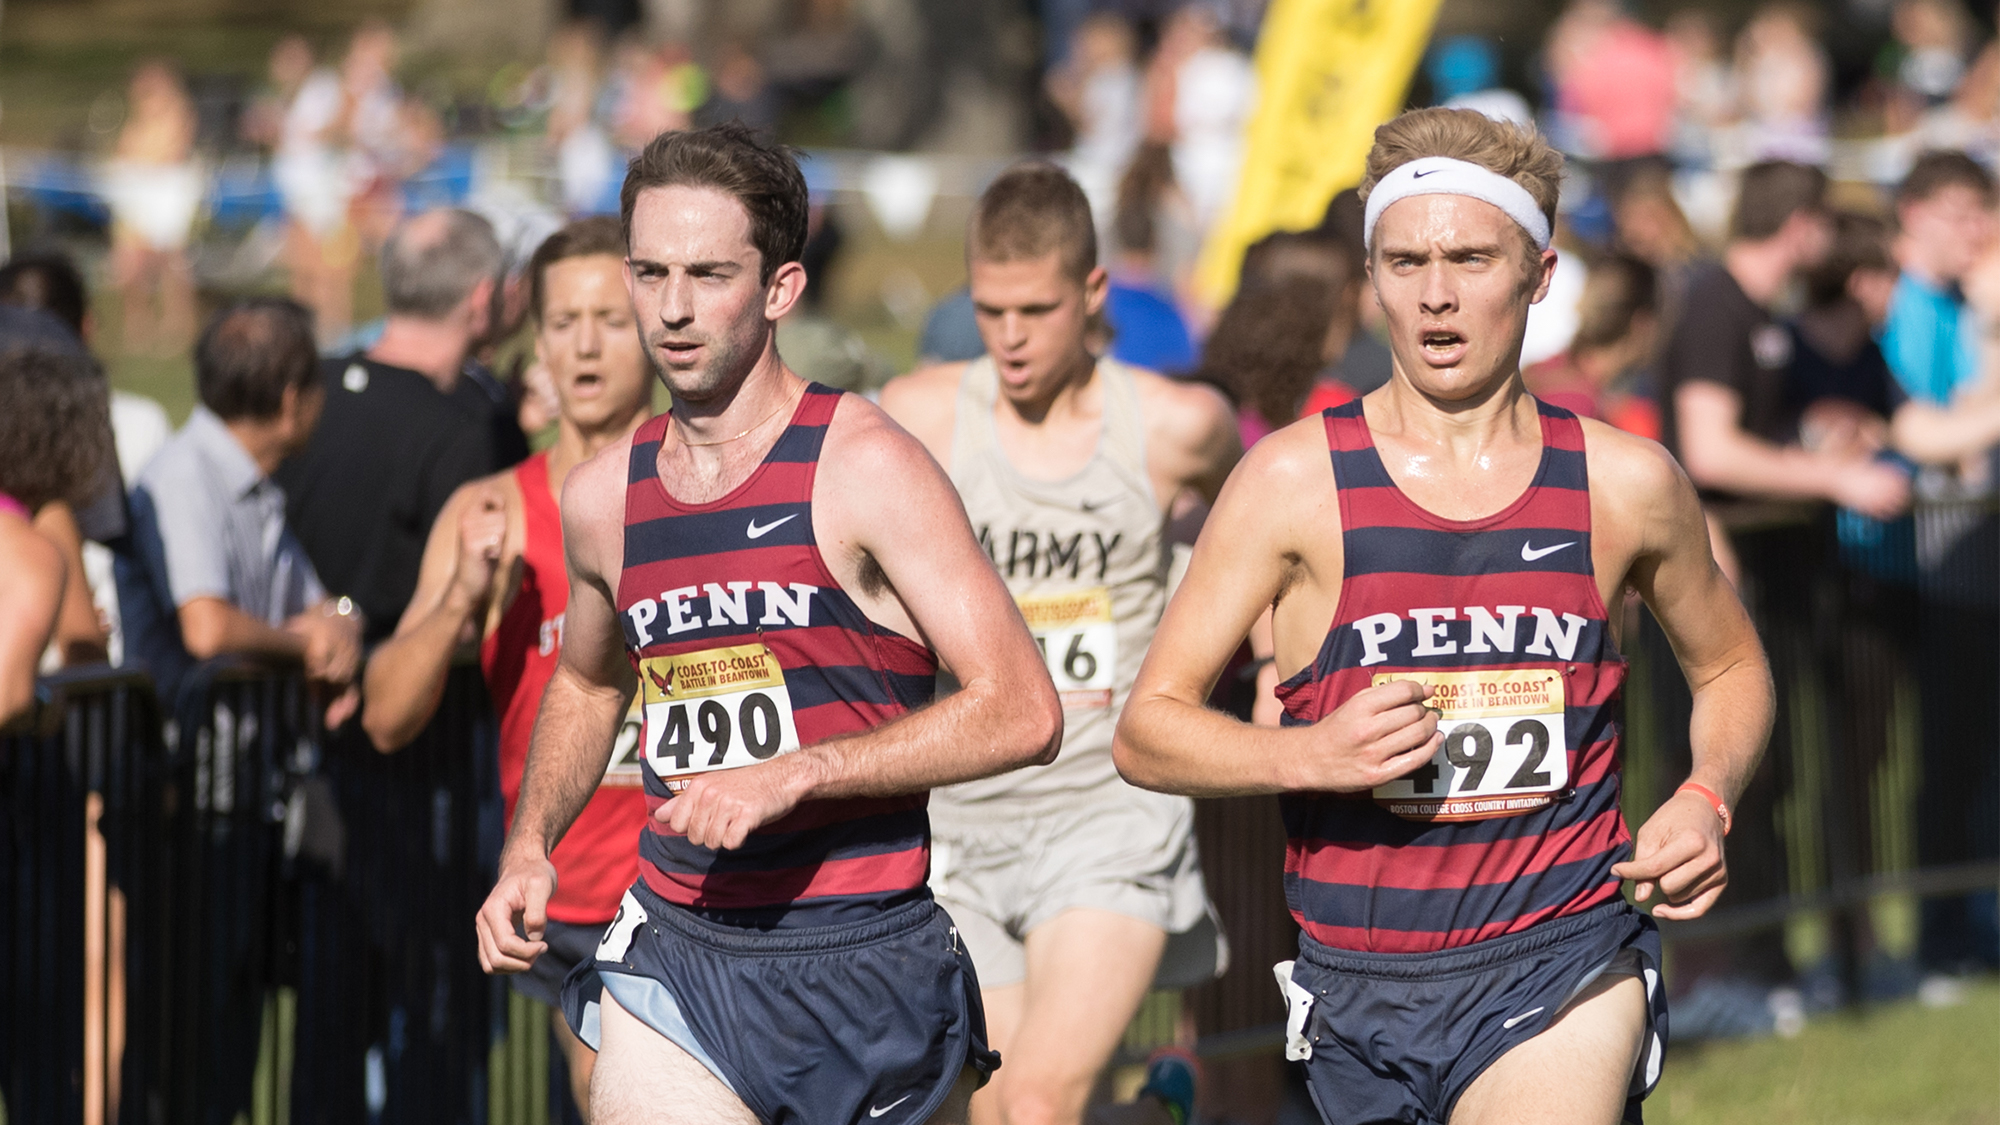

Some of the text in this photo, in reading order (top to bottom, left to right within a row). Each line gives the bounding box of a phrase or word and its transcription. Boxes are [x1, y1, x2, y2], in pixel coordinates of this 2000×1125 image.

[979, 524, 1122, 579] ARMY
[628, 581, 819, 648] PENN
[1352, 605, 1588, 667] PENN
[677, 654, 766, 679] COAST-TO-COAST
[680, 668, 770, 690] BATTLE IN BEANTOWN
[1432, 693, 1550, 710] BATTLE IN BEANTOWN
[1433, 680, 1548, 698] COAST-TO-COAST
[656, 692, 782, 770] 490
[1390, 797, 1551, 814] BOSTON COLLEGE CROSS COUNTRY INVITATIONAL
